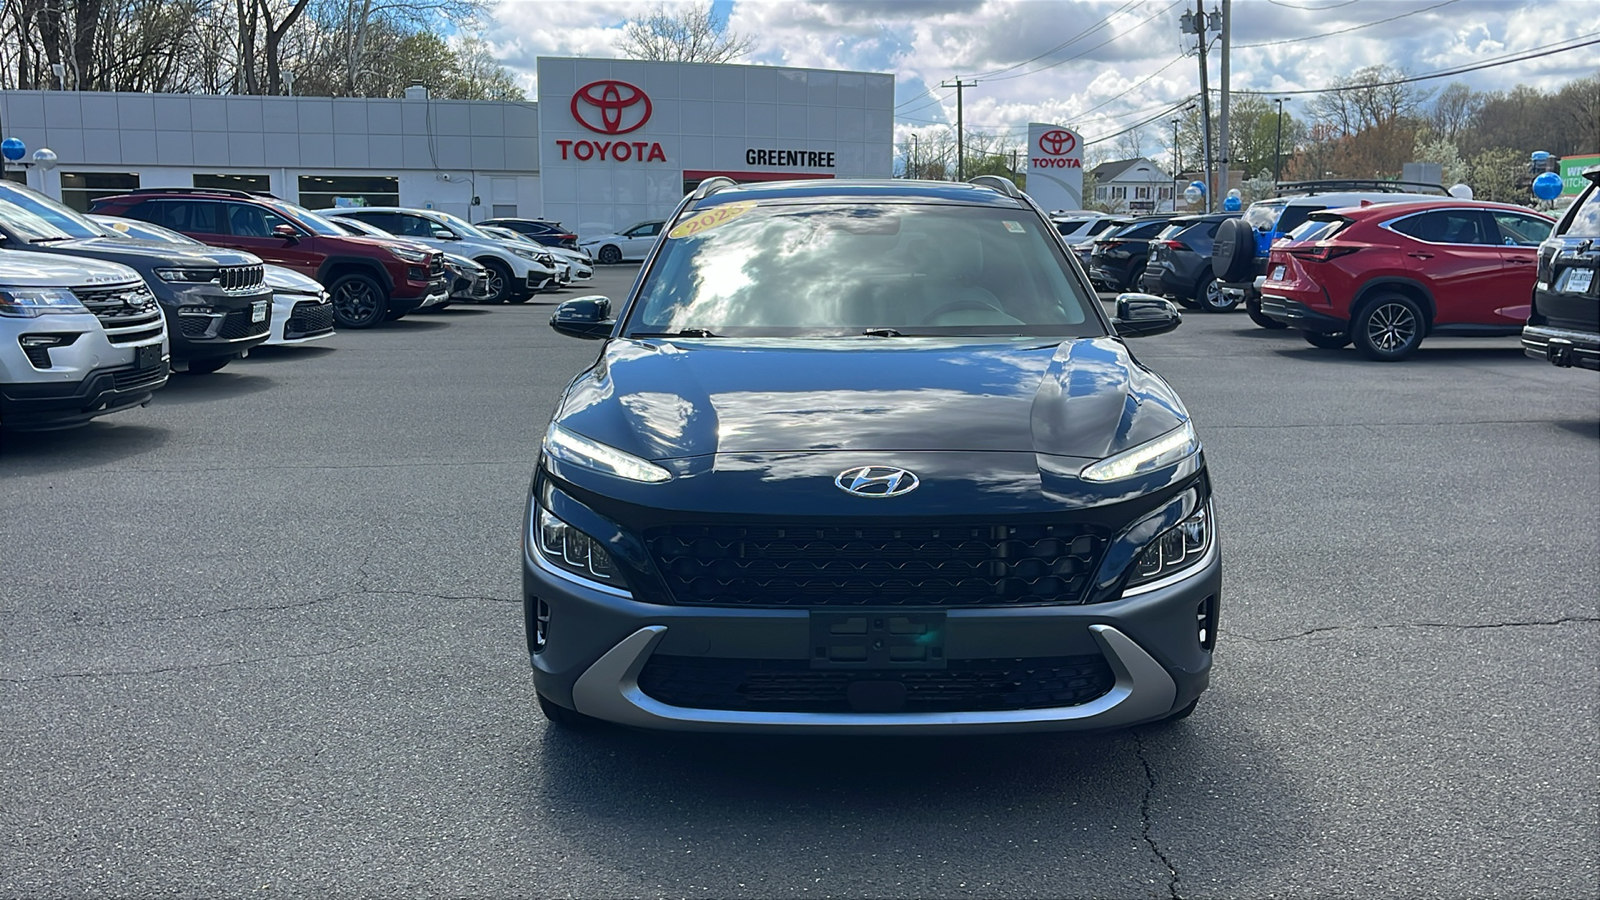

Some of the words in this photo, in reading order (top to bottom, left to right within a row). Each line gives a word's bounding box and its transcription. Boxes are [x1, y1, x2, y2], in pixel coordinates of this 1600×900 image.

[556, 139, 667, 162] TOYOTA
[746, 148, 835, 168] GREENTREE
[1031, 158, 1081, 168] TOYOTA
